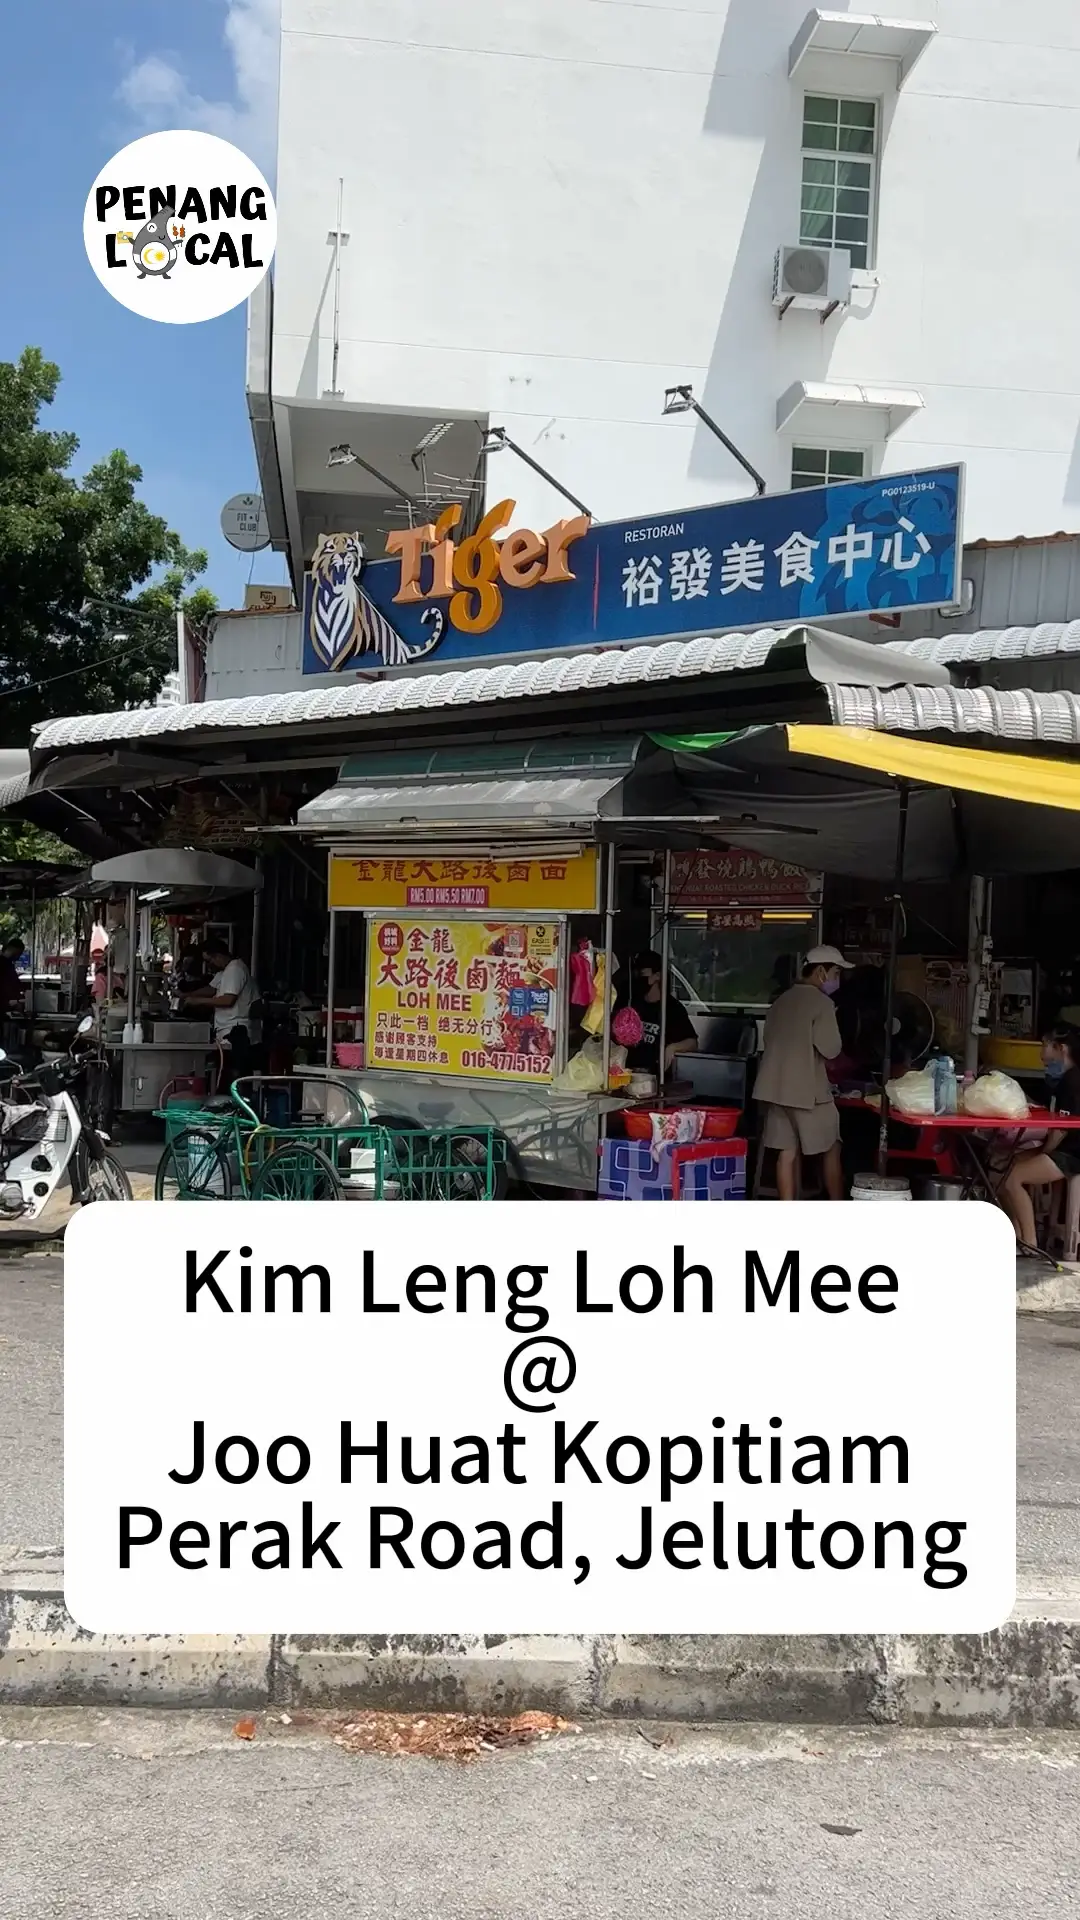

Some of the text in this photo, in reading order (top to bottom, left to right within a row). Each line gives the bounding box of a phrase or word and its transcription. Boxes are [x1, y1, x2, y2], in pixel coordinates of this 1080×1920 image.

[881, 481, 936, 498] PG0123519-U
[236, 512, 248, 522] FIT
[239, 522, 257, 532] CLUB
[624, 522, 685, 544] RESTORAN
[384, 497, 592, 635] Tiger
[621, 515, 932, 610] 裕發美食中心
[410, 887, 485, 905] RM5.00 RM5.50 RM7.00
[406, 927, 456, 954] 金龍
[397, 991, 472, 1012] LOH MEE
[376, 1012, 493, 1036] 只此一档 绝无分行
